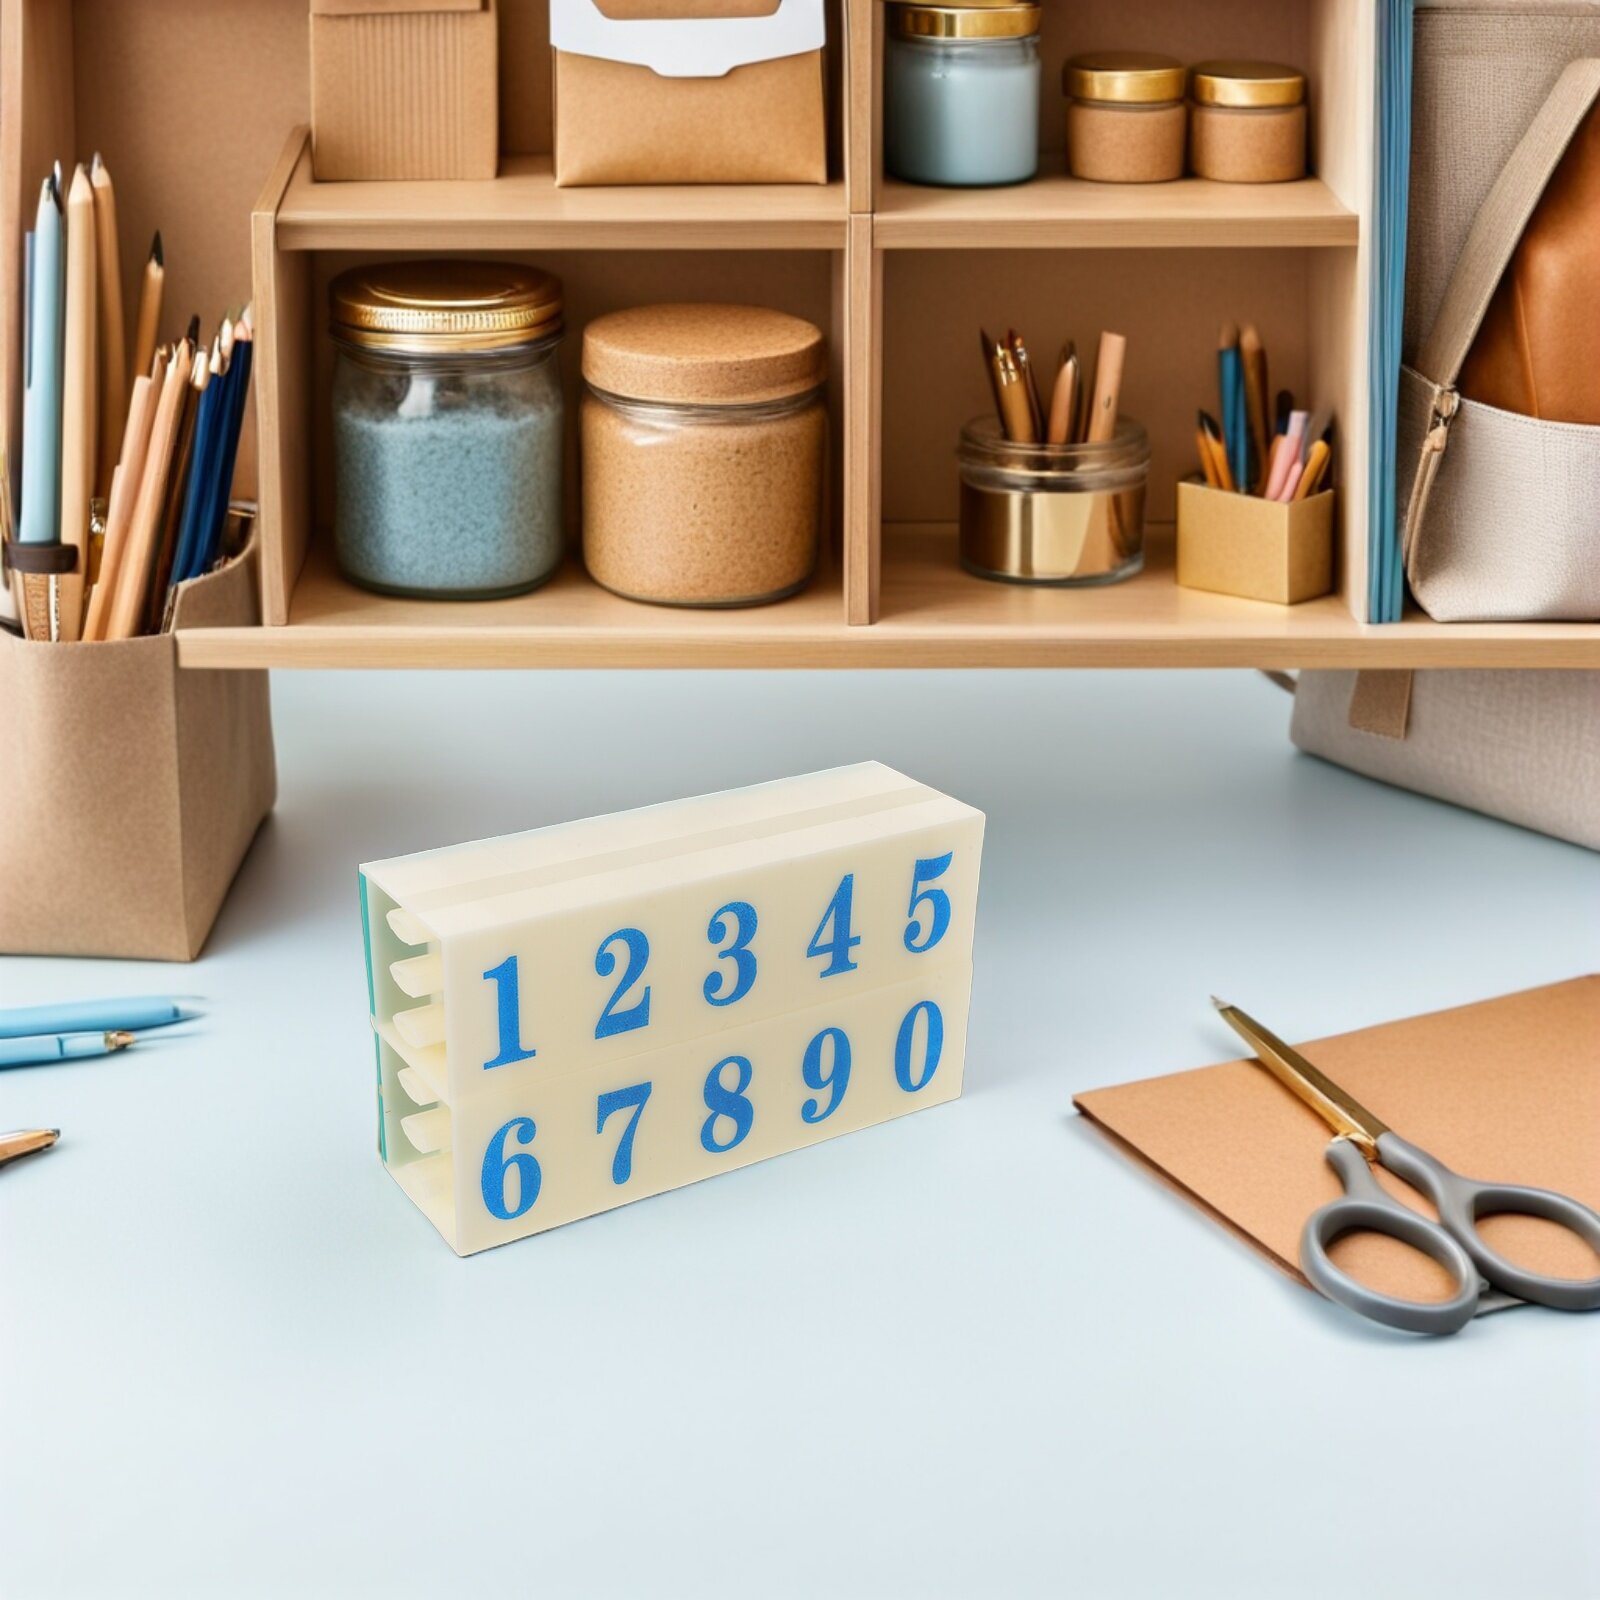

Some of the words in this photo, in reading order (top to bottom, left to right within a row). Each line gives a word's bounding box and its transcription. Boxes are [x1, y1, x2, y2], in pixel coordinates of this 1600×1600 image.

[482, 955, 536, 1070] 1
[594, 928, 651, 1040] 2
[703, 901, 758, 1007] 3
[806, 873, 861, 978] 4
[903, 851, 953, 953] 5
[480, 1116, 542, 1220] 6
[596, 1081, 652, 1185] 7
[700, 1055, 754, 1153] 8
[801, 1027, 852, 1124] 9
[894, 1000, 944, 1093] 0
